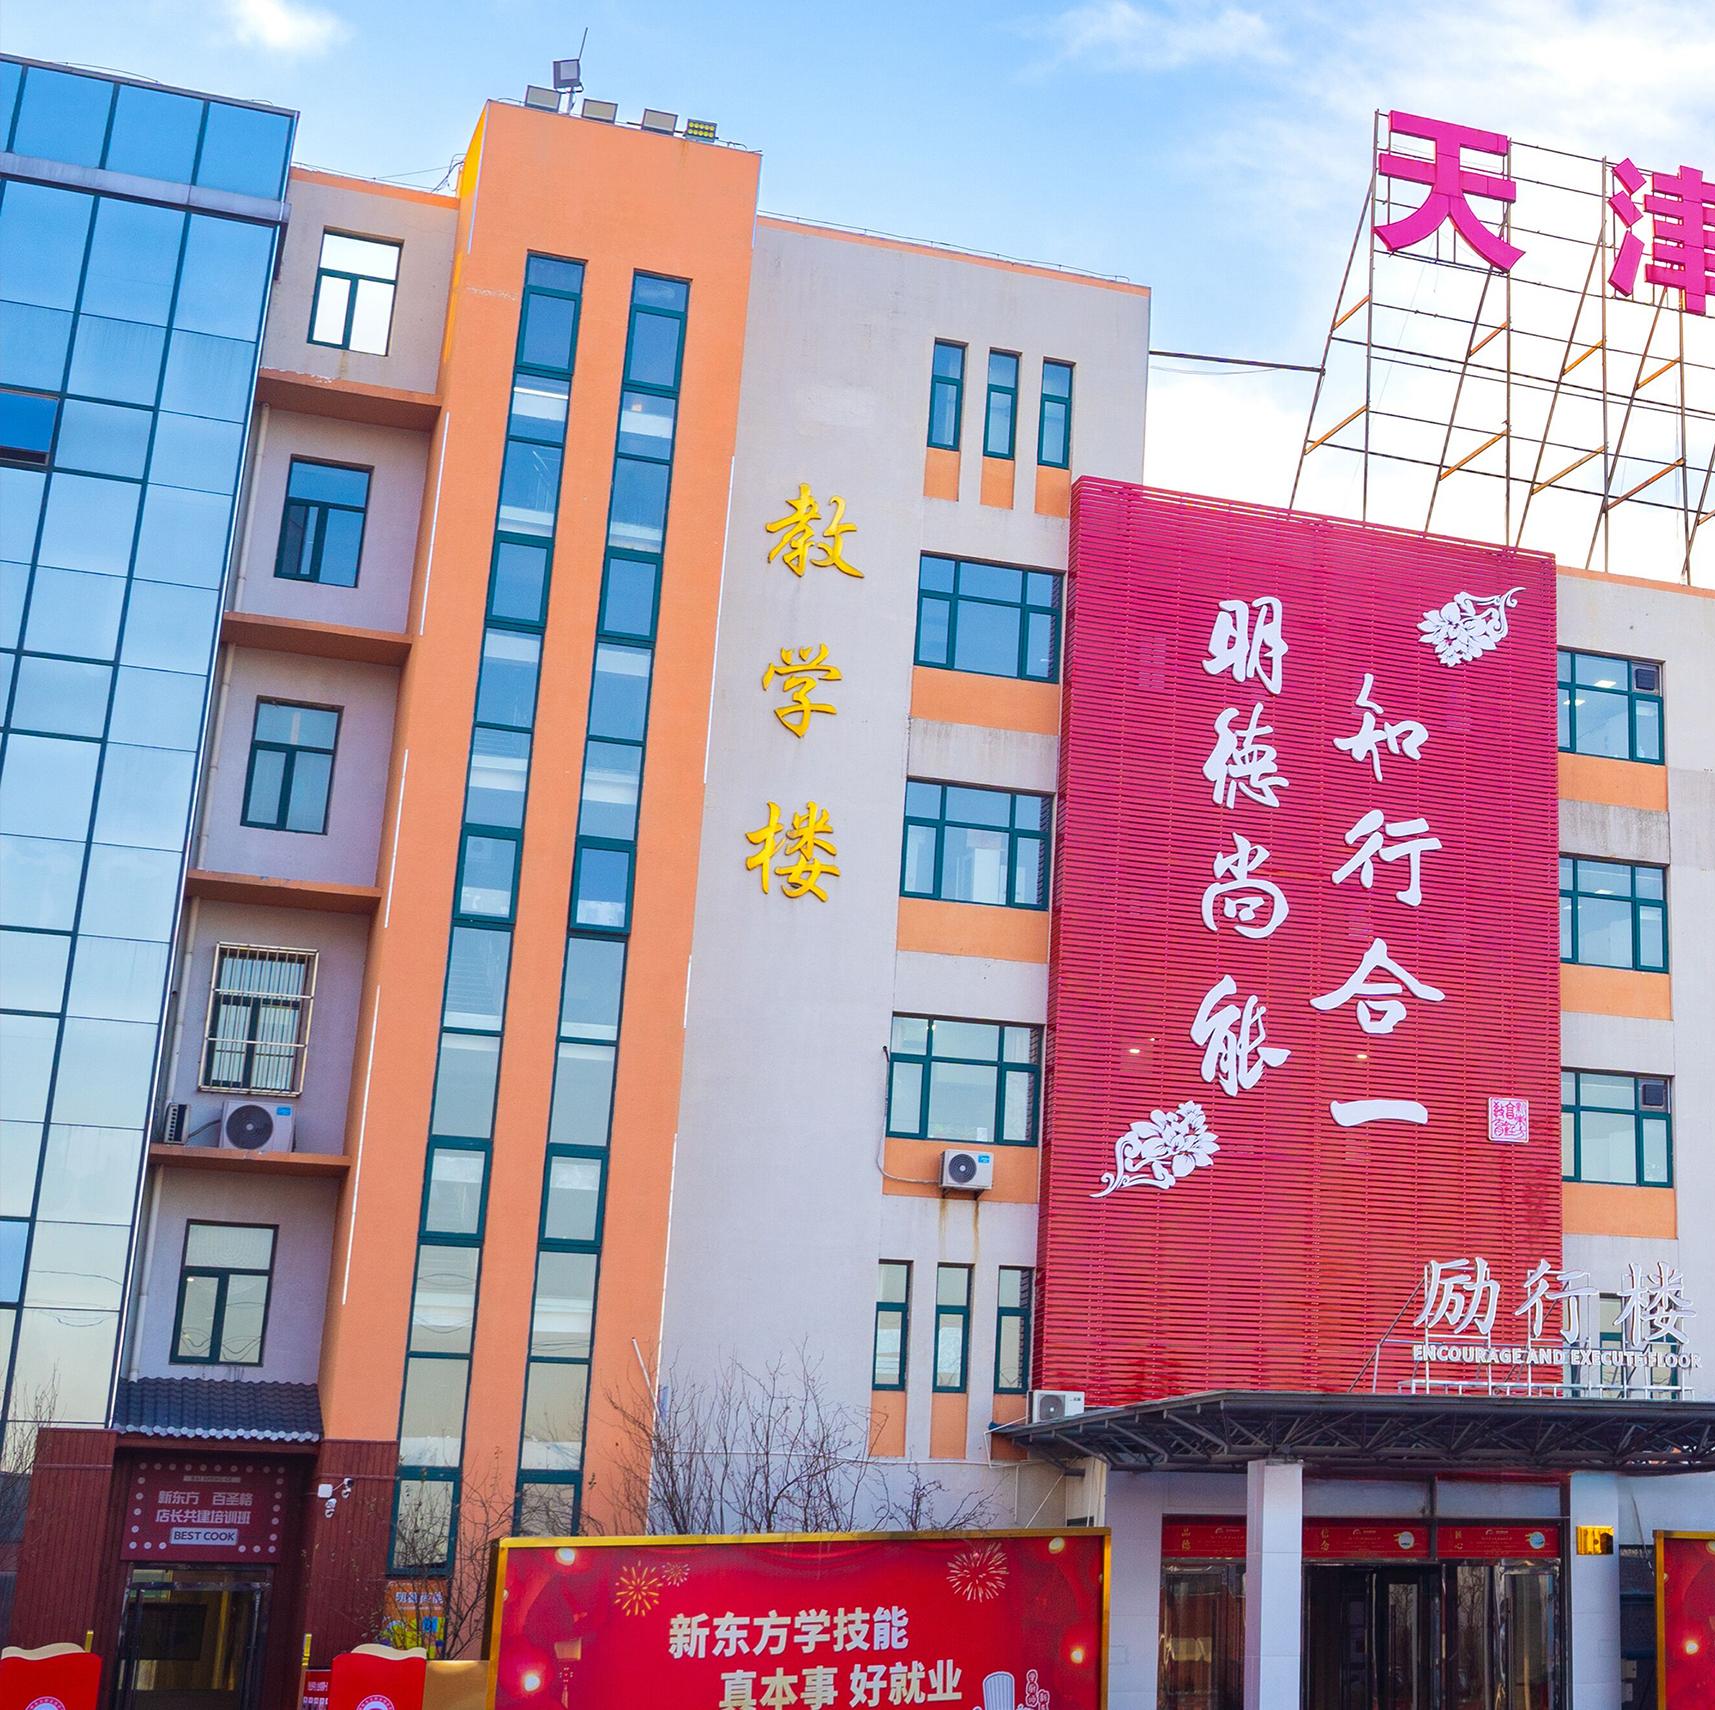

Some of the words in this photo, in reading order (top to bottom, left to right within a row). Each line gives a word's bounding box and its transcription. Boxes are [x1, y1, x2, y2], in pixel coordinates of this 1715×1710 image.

[745, 482, 865, 903] 教学楼
[1190, 596, 1292, 1098] 明德尚能
[1309, 673, 1447, 1128] 知行合一
[1413, 1257, 1697, 1347] 励行楼
[1412, 1344, 1527, 1365] ENCOURAGE
[1527, 1349, 1566, 1366] AND
[1570, 1349, 1646, 1368] EXECUTE
[1648, 1352, 1703, 1369] FLOOR
[158, 1490, 201, 1505] 新东方
[173, 1530, 201, 1541] BEST
[203, 1531, 235, 1542] COOK
[668, 1605, 909, 1660] 新东方学技能
[718, 1665, 839, 1710] 真本事
[849, 1658, 963, 1708] 好就业
